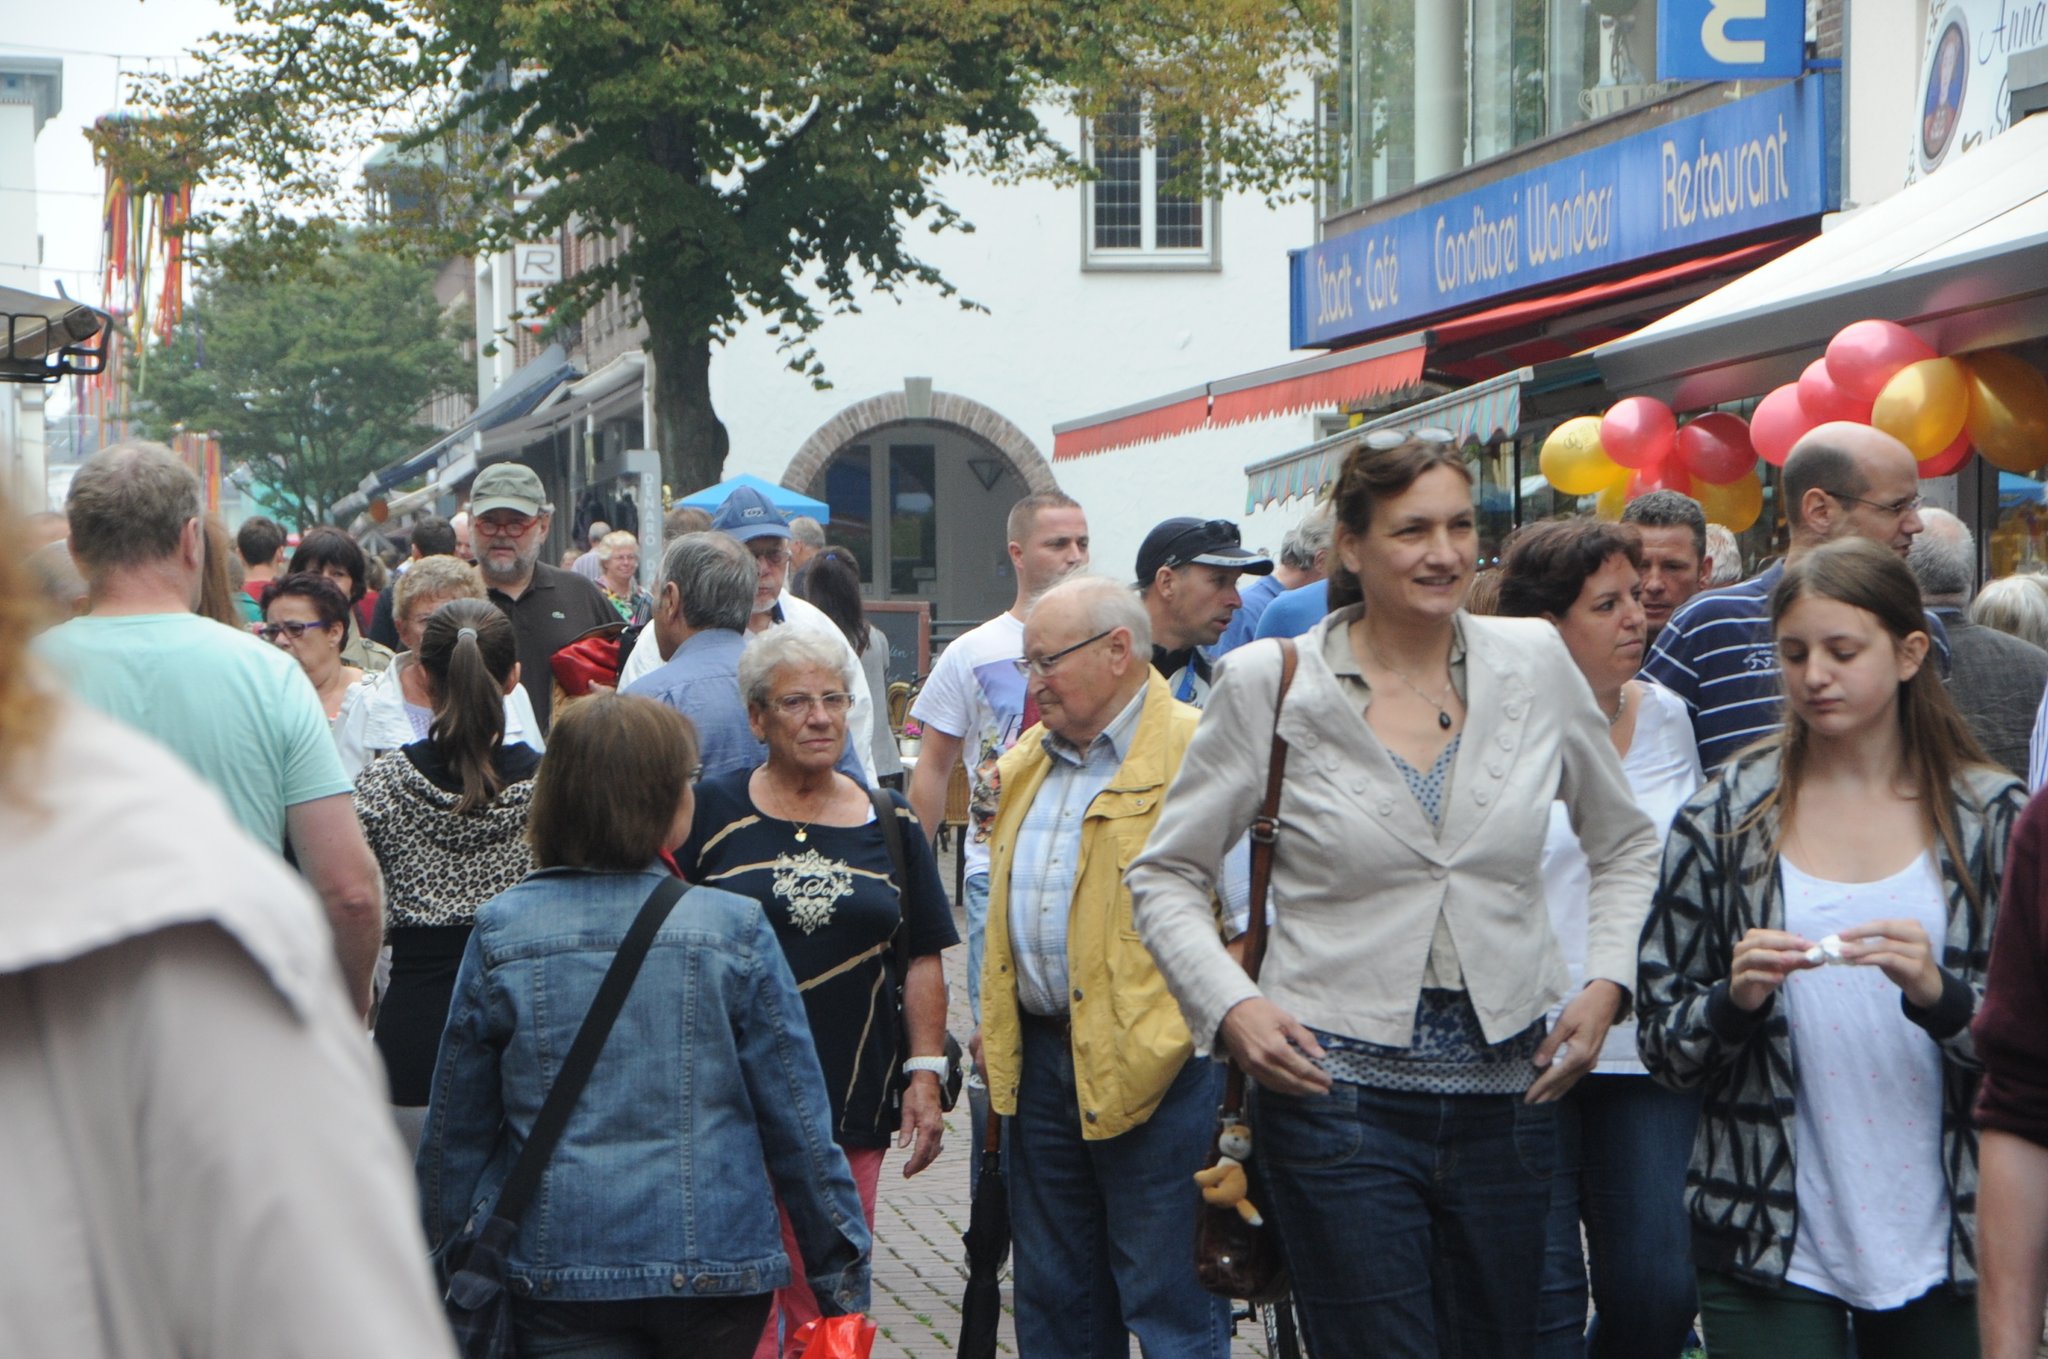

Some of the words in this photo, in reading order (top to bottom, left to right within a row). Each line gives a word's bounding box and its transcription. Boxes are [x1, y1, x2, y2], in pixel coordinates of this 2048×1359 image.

[1365, 234, 1398, 312] Café
[1434, 190, 1519, 294] Conditorei
[1661, 112, 1789, 231] Restaurant
[523, 249, 556, 275] R
[643, 472, 656, 547] DENARO
